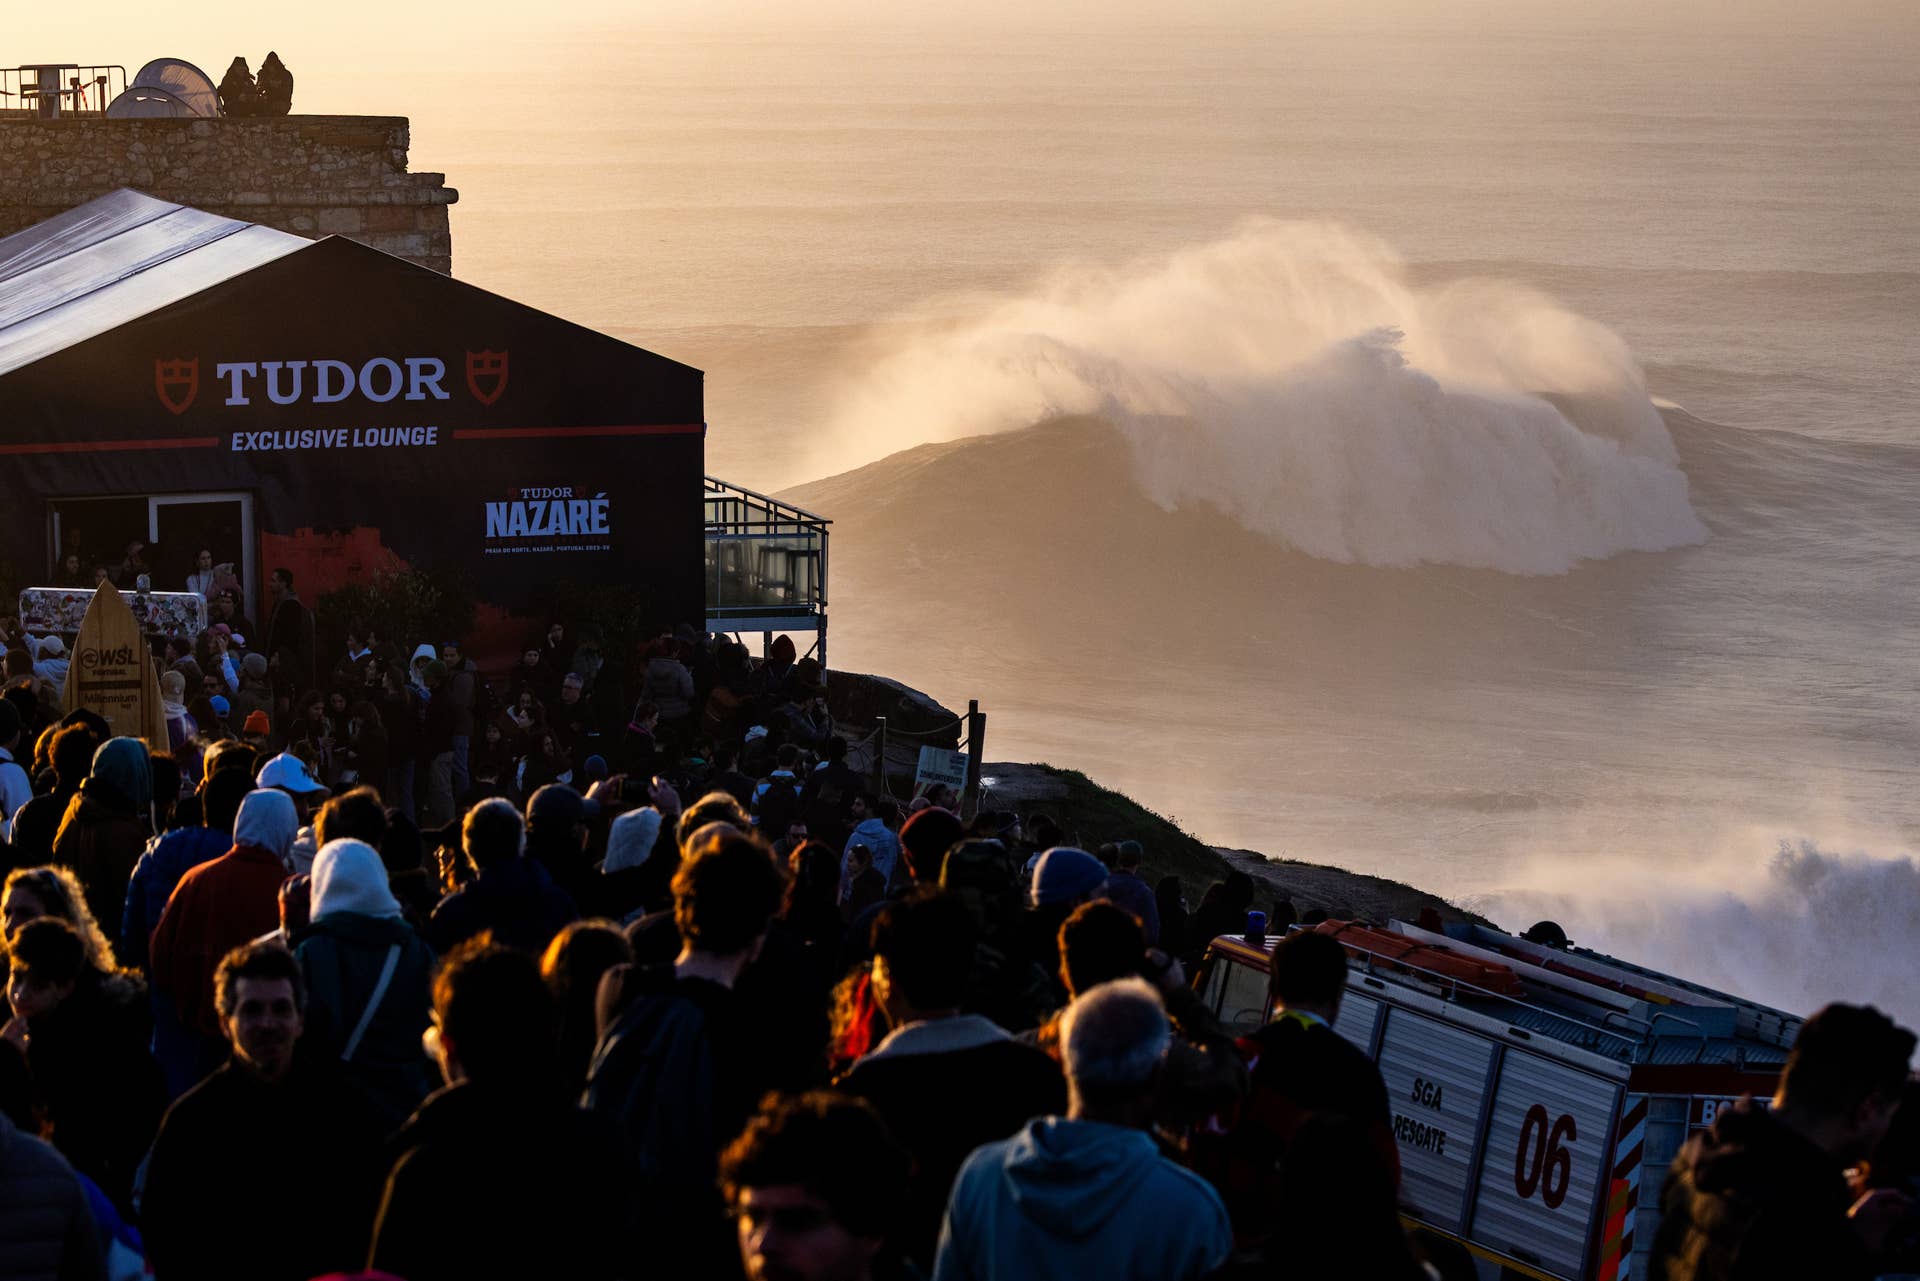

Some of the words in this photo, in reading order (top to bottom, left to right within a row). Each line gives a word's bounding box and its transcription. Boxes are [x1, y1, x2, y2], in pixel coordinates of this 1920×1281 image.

[216, 357, 450, 406] TUDOR
[231, 429, 349, 451] EXCLUSIVE
[352, 426, 438, 449] LOUNGE
[520, 487, 573, 499] TUDOR
[485, 491, 610, 538] NAZARÉ
[99, 648, 140, 666] WSL
[84, 693, 138, 704] Millennium
[1412, 1078, 1442, 1111] SGA
[1393, 1115, 1447, 1155] RESGATE
[1515, 1104, 1577, 1209] 06
